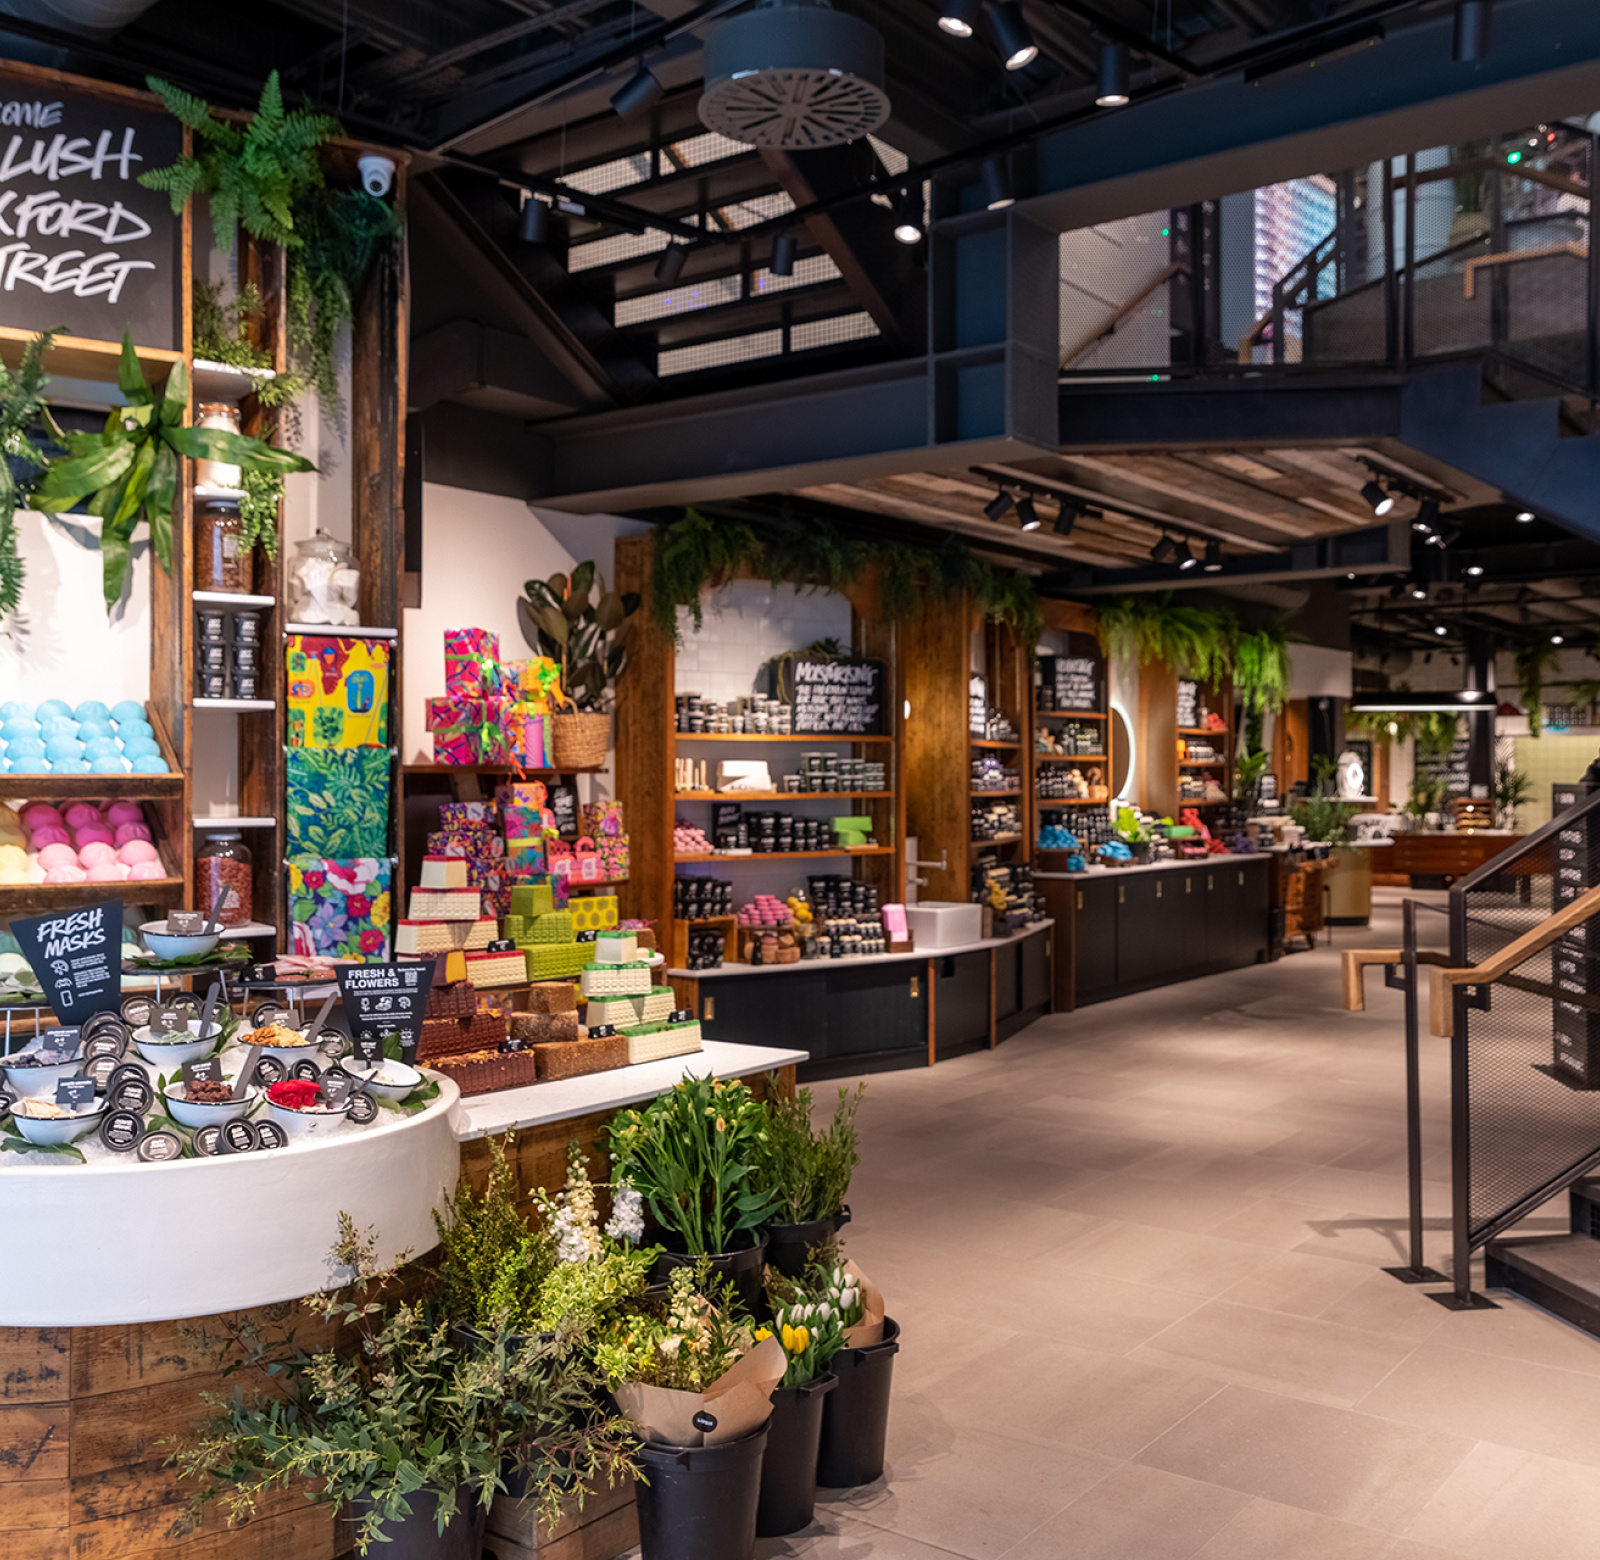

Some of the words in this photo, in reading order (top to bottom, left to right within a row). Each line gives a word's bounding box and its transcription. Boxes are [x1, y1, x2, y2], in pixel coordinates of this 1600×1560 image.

[0, 101, 64, 128] OME
[0, 127, 143, 181] LUSH
[37, 908, 104, 943] FRESH
[44, 928, 106, 959] MASKS
[345, 977, 400, 989] FLOWERS
[348, 968, 385, 979] FRESH
[387, 968, 396, 977] &
